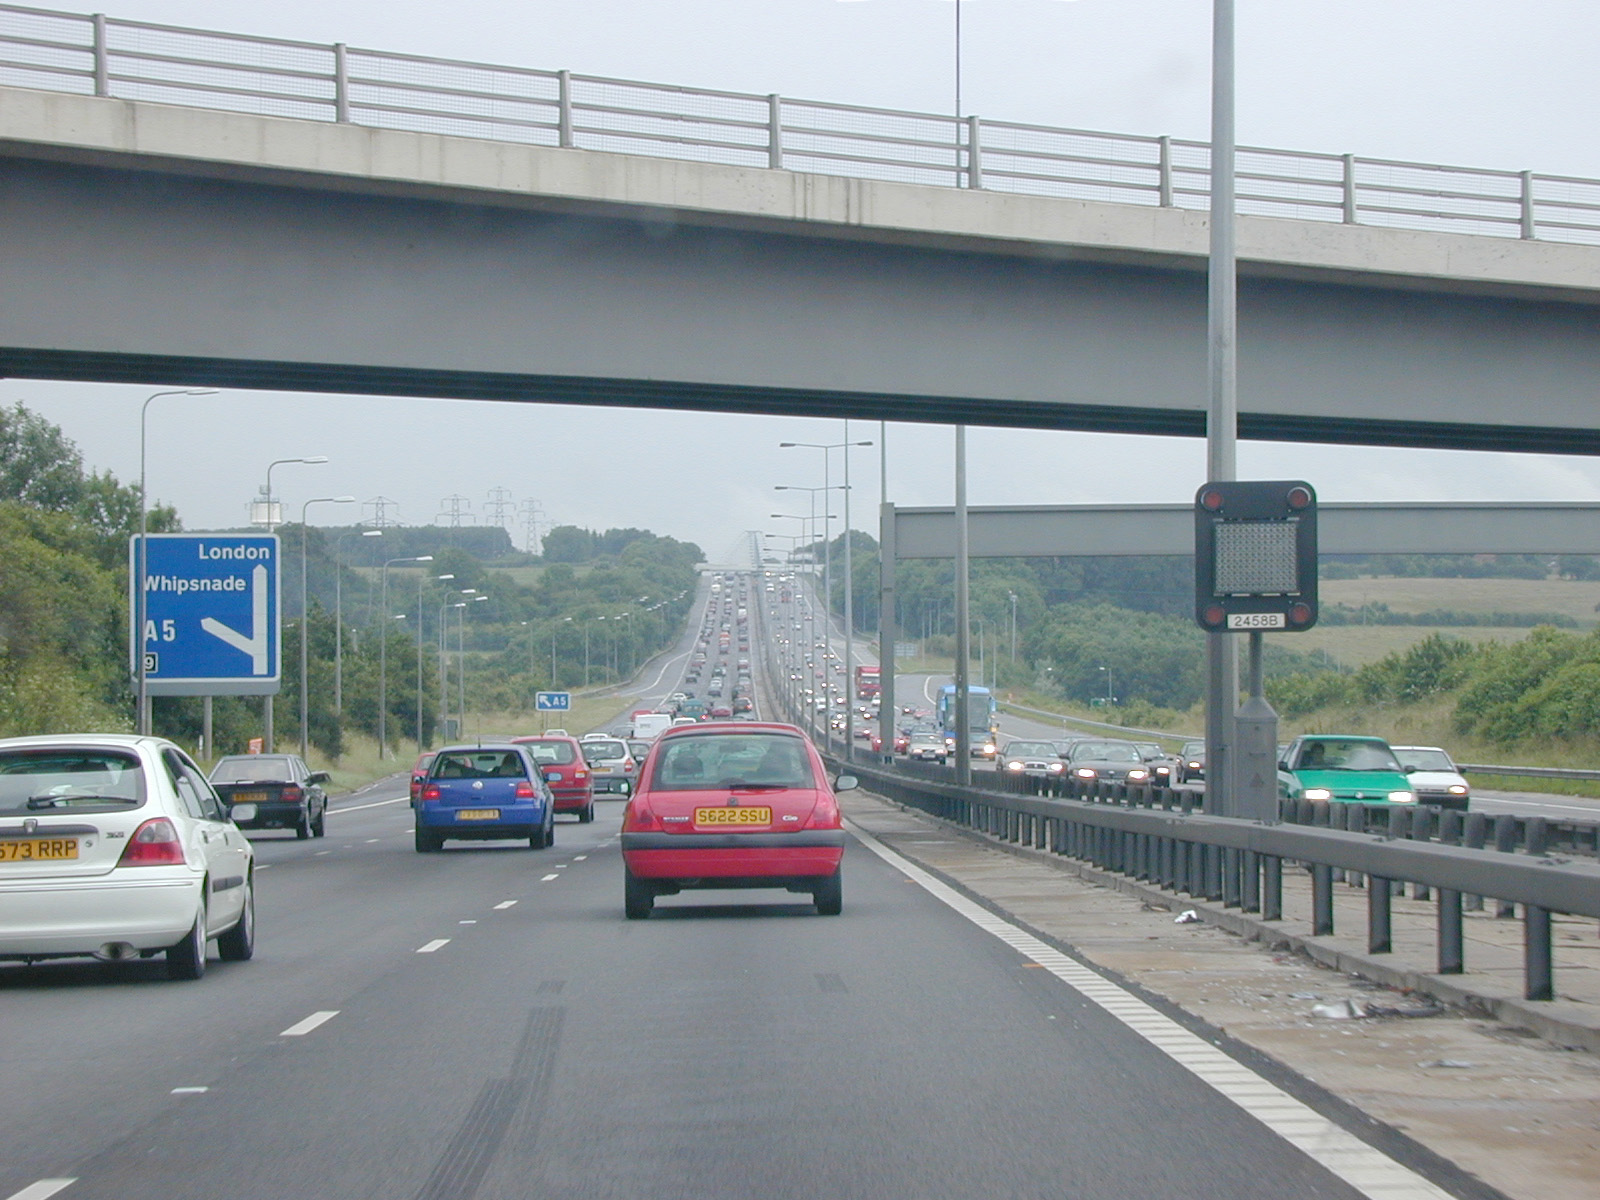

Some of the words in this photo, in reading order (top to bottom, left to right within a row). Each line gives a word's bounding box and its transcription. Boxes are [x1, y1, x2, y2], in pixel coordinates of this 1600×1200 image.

[199, 543, 270, 560] London
[144, 575, 247, 595] Whipsnade
[1234, 615, 1278, 627] 2458B
[38, 839, 77, 858] RRP
